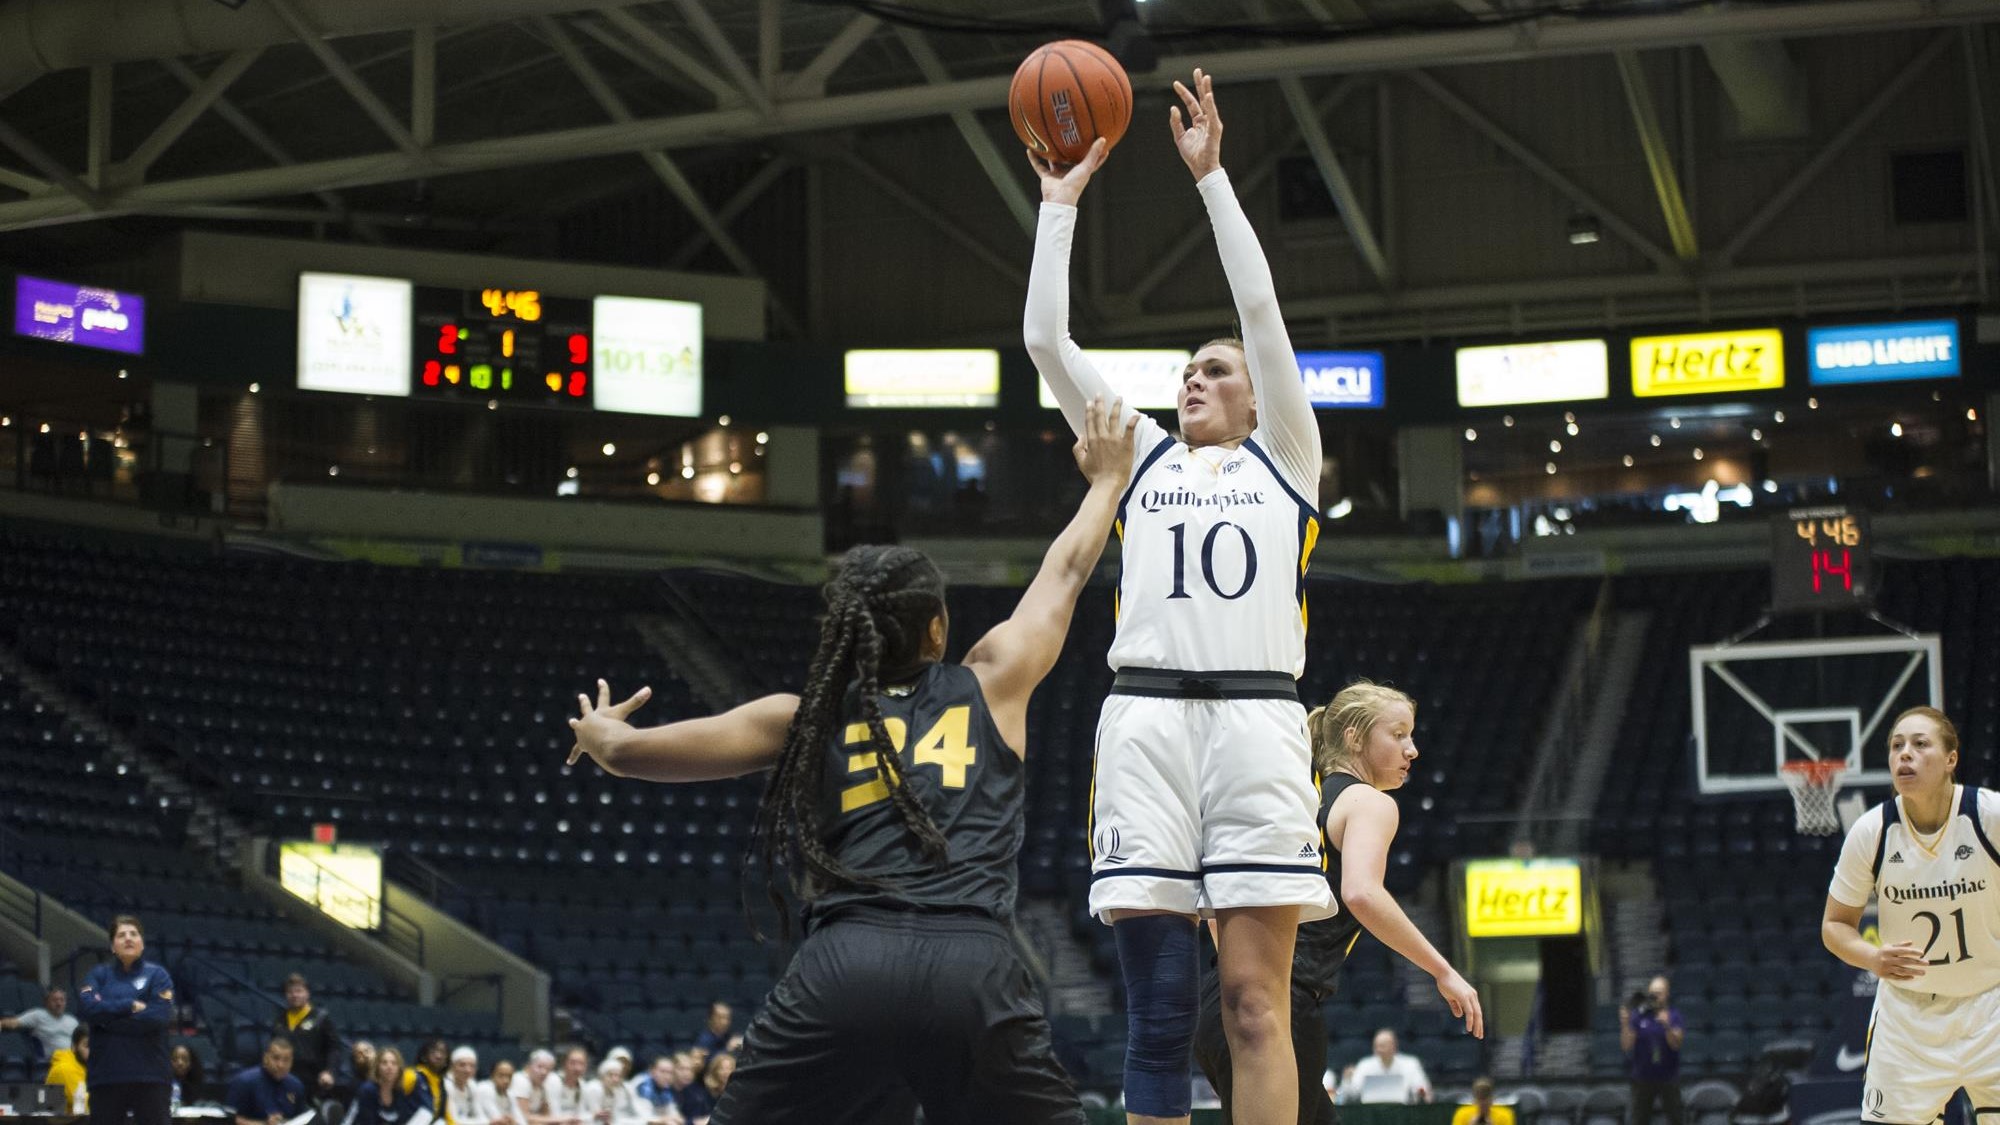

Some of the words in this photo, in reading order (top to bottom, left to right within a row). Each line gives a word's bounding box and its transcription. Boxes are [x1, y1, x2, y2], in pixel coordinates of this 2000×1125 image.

[1052, 89, 1080, 147] ELITE
[482, 288, 541, 321] 4:46
[438, 324, 458, 354] 2
[502, 329, 515, 358] 1
[568, 333, 588, 364] 9
[1816, 340, 1873, 369] BUD
[1873, 334, 1952, 365] LIGHT
[1651, 343, 1764, 377] Hertz
[1166, 521, 1257, 600] 10
[1812, 548, 1852, 592] 14
[1477, 885, 1569, 917] Hertz
[1884, 877, 1986, 905] Quinnipiac
[1911, 907, 1974, 965] 21
